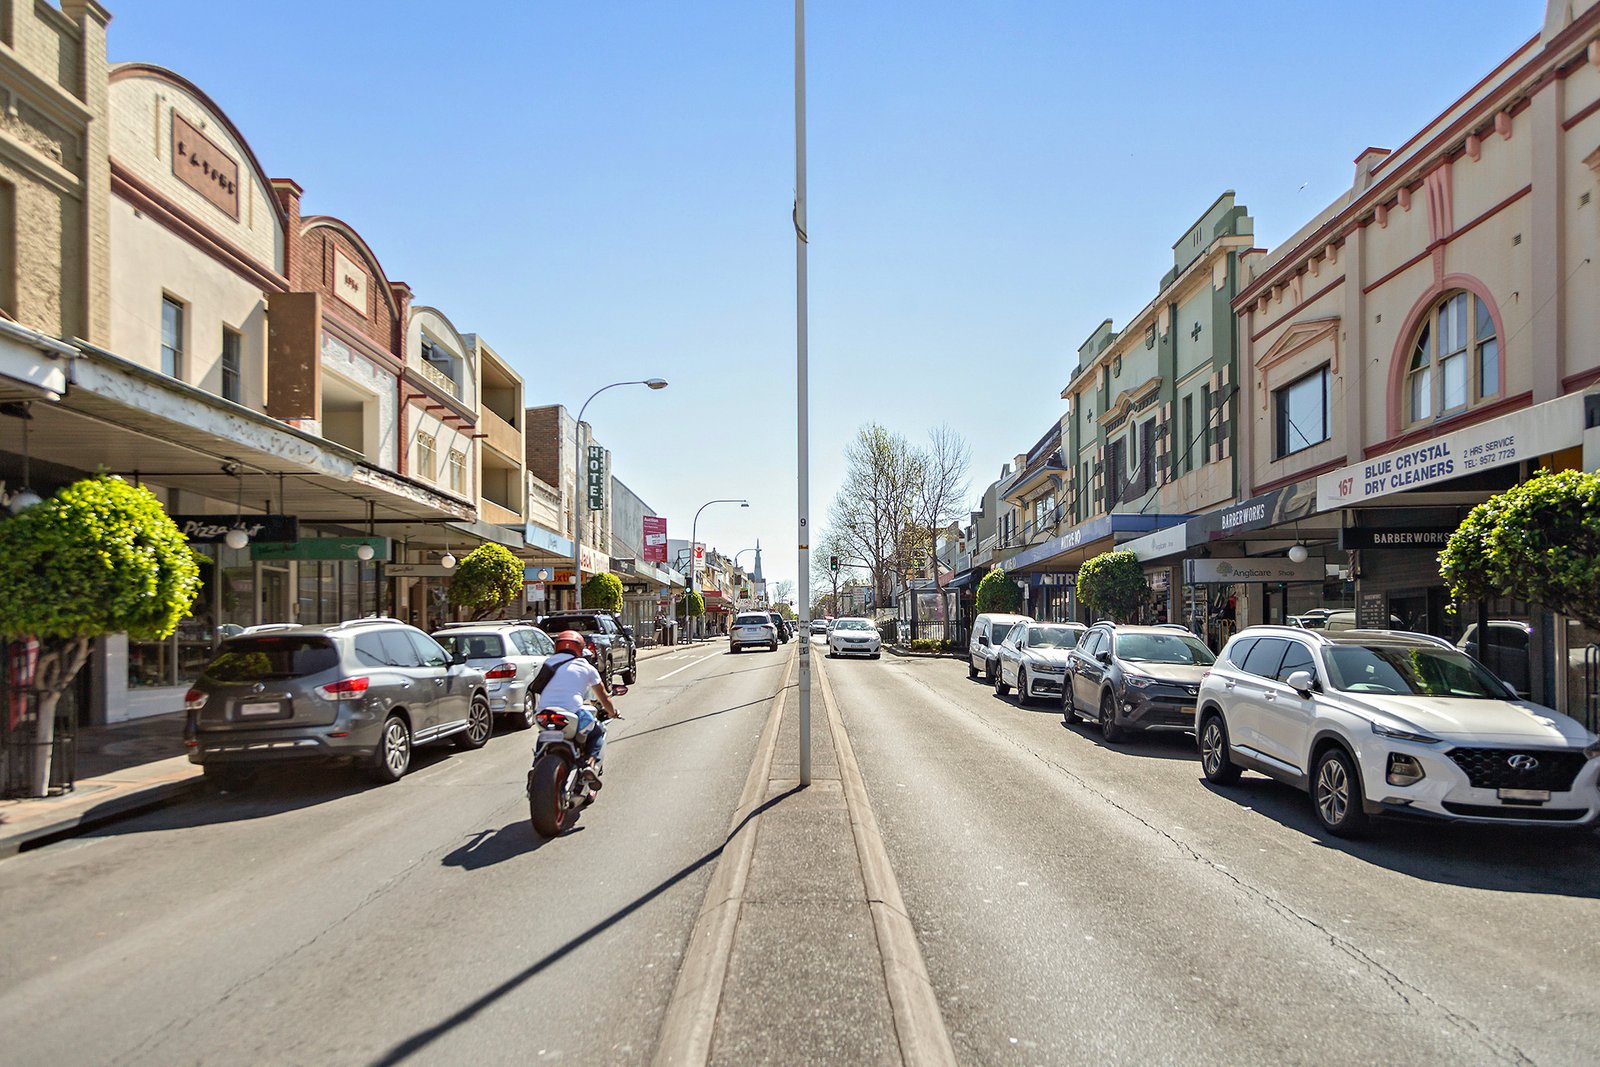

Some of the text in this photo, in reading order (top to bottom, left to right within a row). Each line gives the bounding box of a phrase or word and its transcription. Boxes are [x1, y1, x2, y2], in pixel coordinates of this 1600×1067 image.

[1463, 436, 1515, 459] 2 HRS SERVICE
[1365, 442, 1450, 479] BLUE CRYSTAL
[1464, 448, 1516, 469] TEL: 9572 7729
[590, 447, 599, 509] HOTEL
[1338, 477, 1353, 497] 167
[1365, 460, 1454, 495] DRY CLEANERS
[801, 519, 807, 527] 9
[1221, 503, 1265, 529] BARBERWORKS
[183, 520, 229, 538] Pizza
[1373, 532, 1450, 544] BARBERWORKS
[1233, 569, 1295, 578] Anglicare Shop
